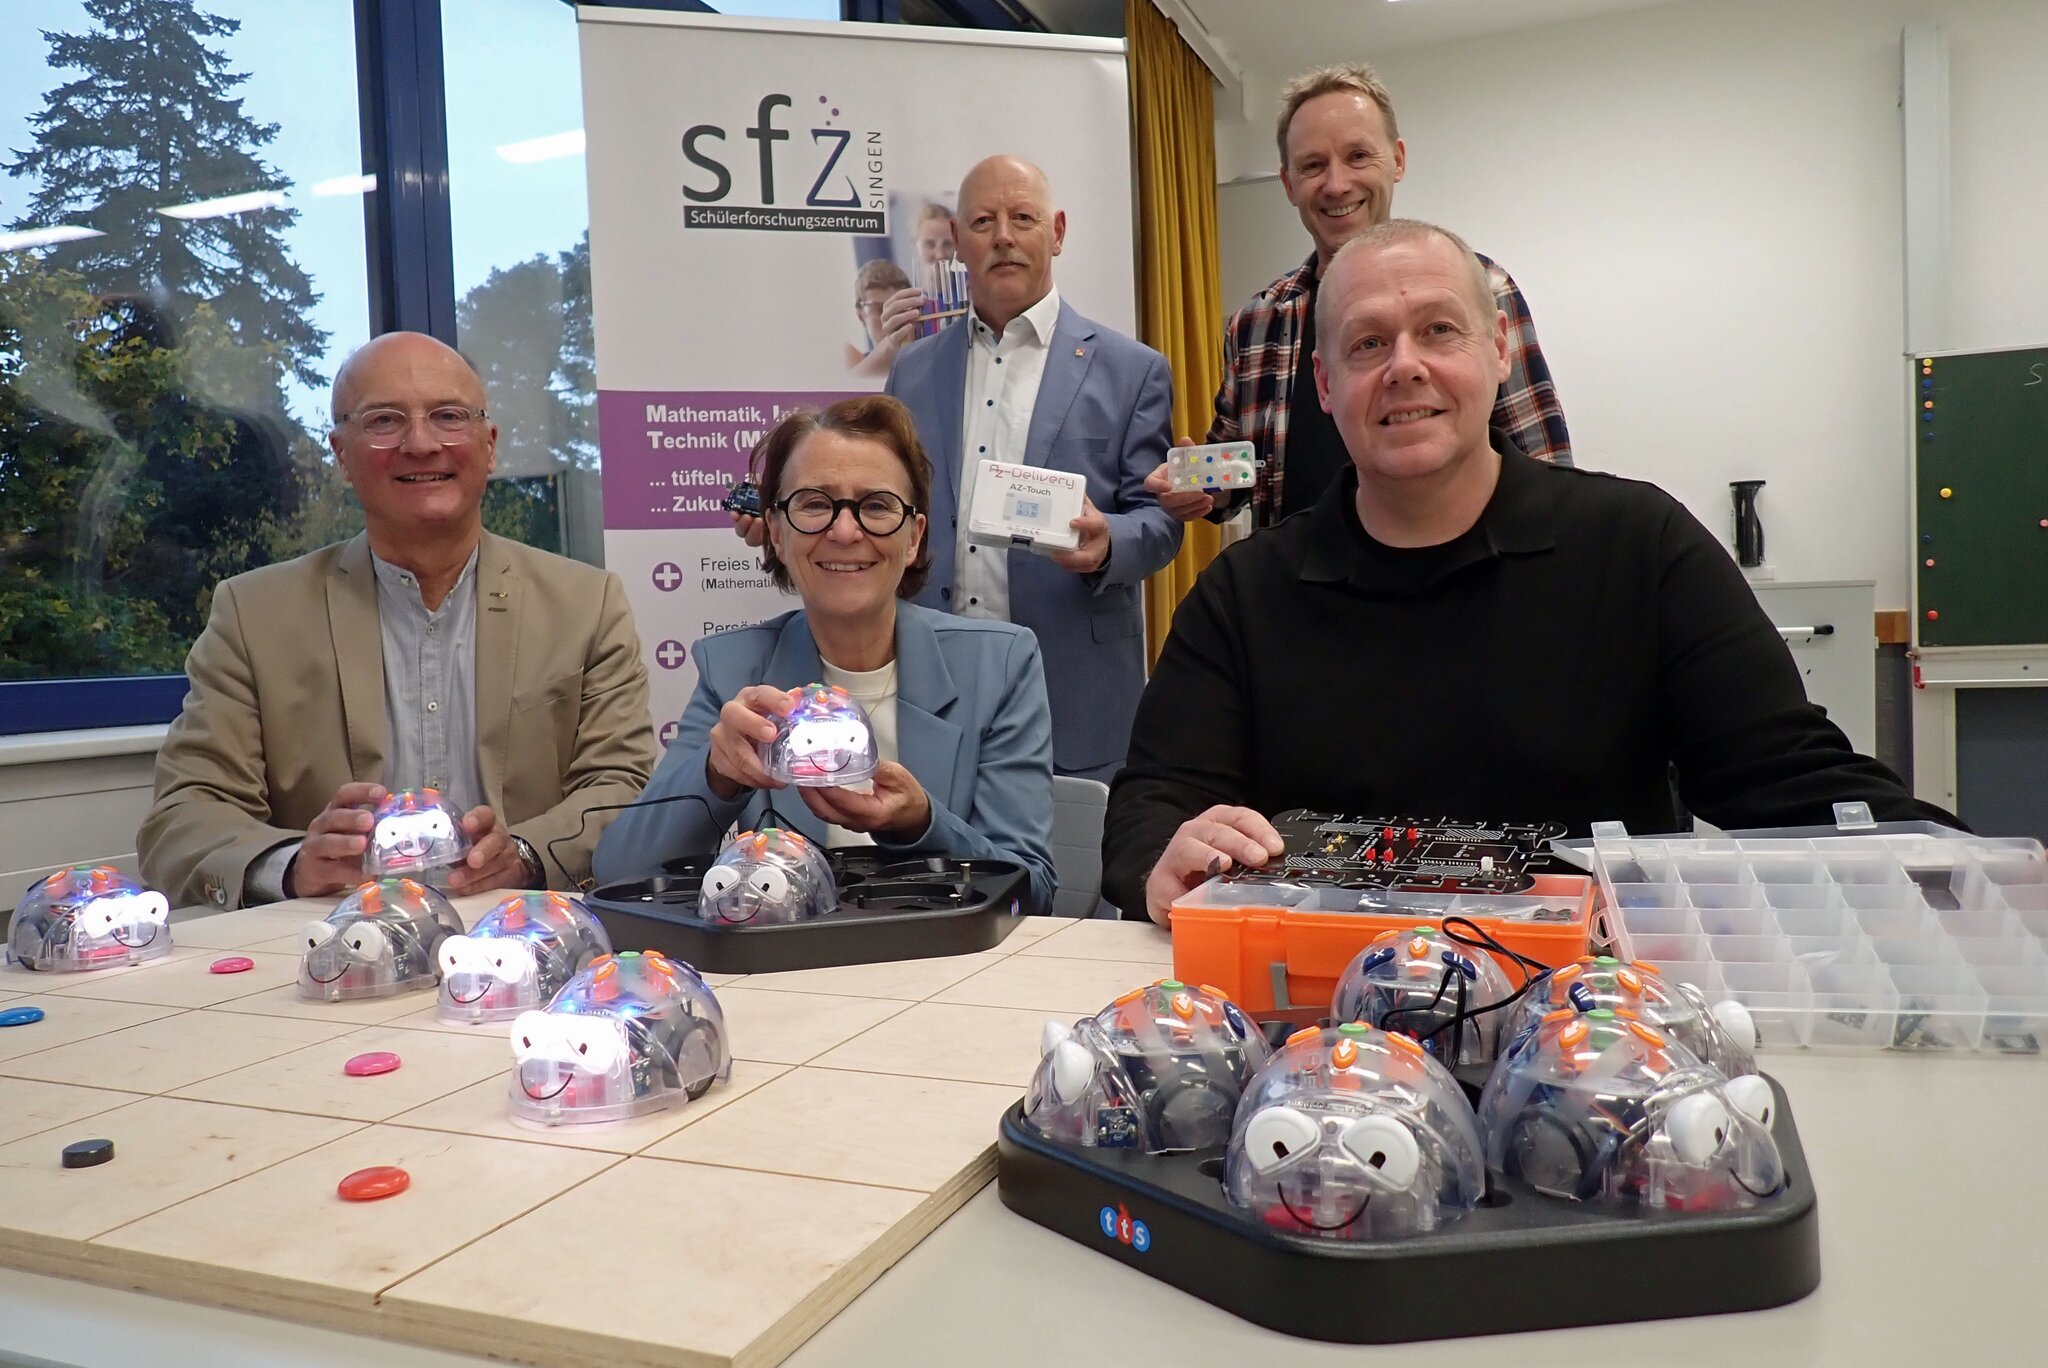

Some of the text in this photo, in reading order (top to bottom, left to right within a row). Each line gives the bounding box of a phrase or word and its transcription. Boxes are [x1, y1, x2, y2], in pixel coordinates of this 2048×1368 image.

[867, 131, 884, 209] SINGEN
[690, 210, 878, 229] Schülerforschungszentrum
[646, 405, 766, 425] Mathematik,
[647, 431, 728, 449] Technik
[1009, 483, 1051, 496] AZ-Touch
[673, 496, 725, 512] Zuku
[700, 557, 750, 571] Freies
[1105, 1211, 1146, 1246] tts
